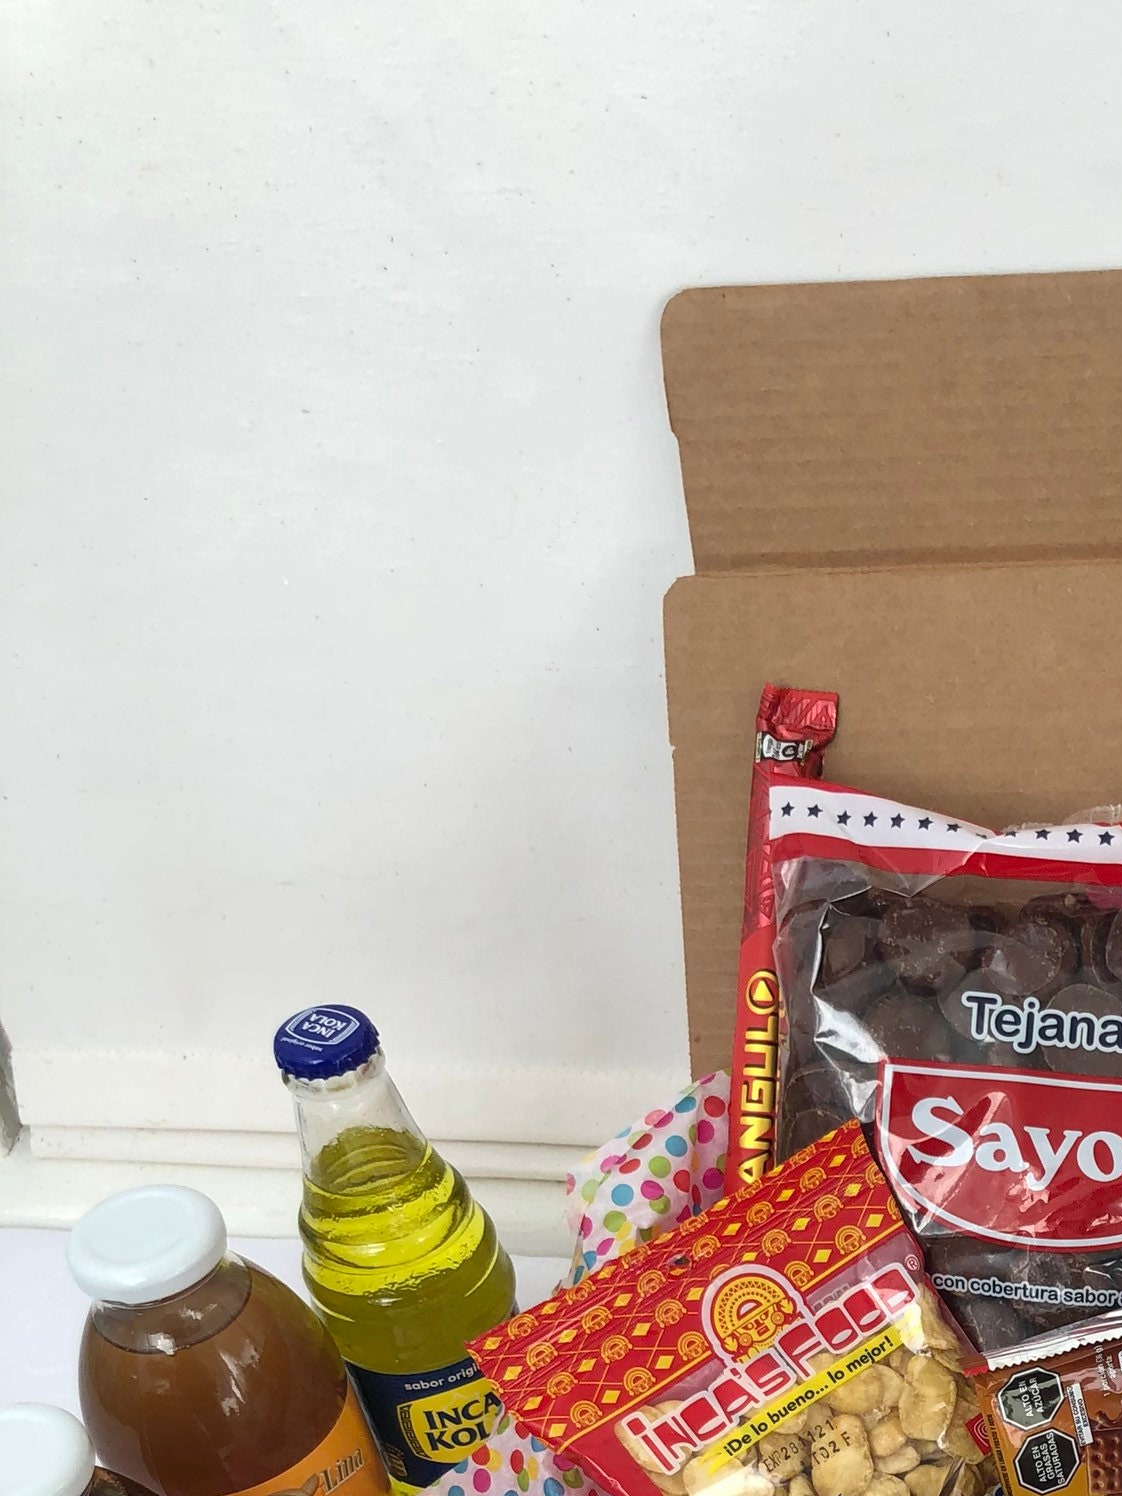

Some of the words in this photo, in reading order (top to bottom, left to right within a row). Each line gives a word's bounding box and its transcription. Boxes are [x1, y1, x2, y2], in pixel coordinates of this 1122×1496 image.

[302, 1021, 335, 1038] INCA
[309, 1014, 347, 1031] KOLA
[933, 1274, 966, 1292] con
[969, 1279, 1058, 1303] cobertura
[1061, 1289, 1118, 1306] sabor
[404, 1378, 444, 1390] sabor
[723, 1435, 751, 1456] ¡De
[751, 1423, 768, 1435] lo
[767, 1384, 829, 1424] bueno...
[827, 1369, 845, 1383] lo
[846, 1336, 893, 1372] mejor!
[1022, 1394, 1034, 1417] ALTO
[423, 1392, 502, 1430] INCA
[1032, 1446, 1040, 1460] EN
[1040, 1443, 1054, 1480] GRASAS
[1046, 1432, 1066, 1484] SATURADAS
[1036, 1461, 1047, 1482] ALTO
